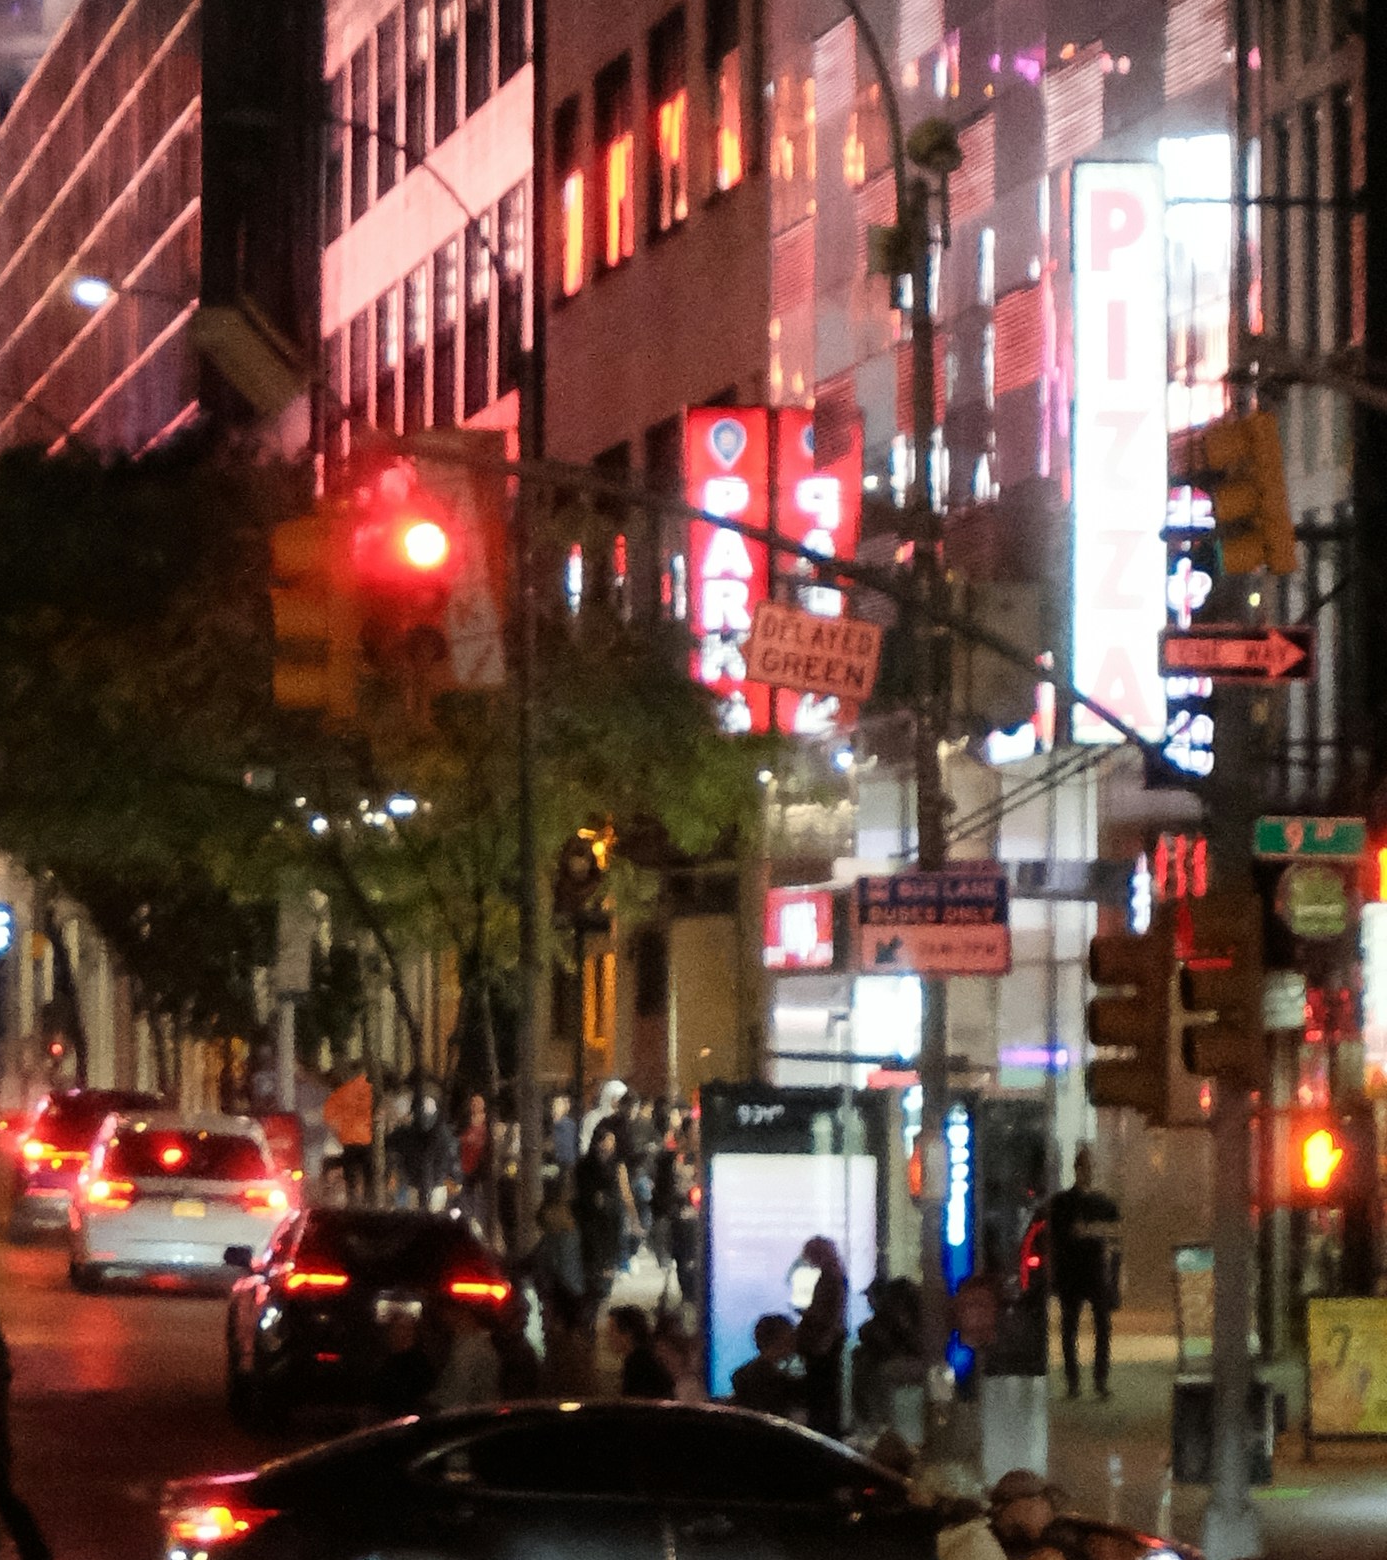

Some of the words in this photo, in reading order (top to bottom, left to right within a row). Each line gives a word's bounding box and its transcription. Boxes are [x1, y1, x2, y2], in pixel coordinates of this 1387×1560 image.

[1090, 190, 1159, 728] PIZZA
[761, 613, 874, 655] DELAYED
[762, 647, 865, 688] GREEN
